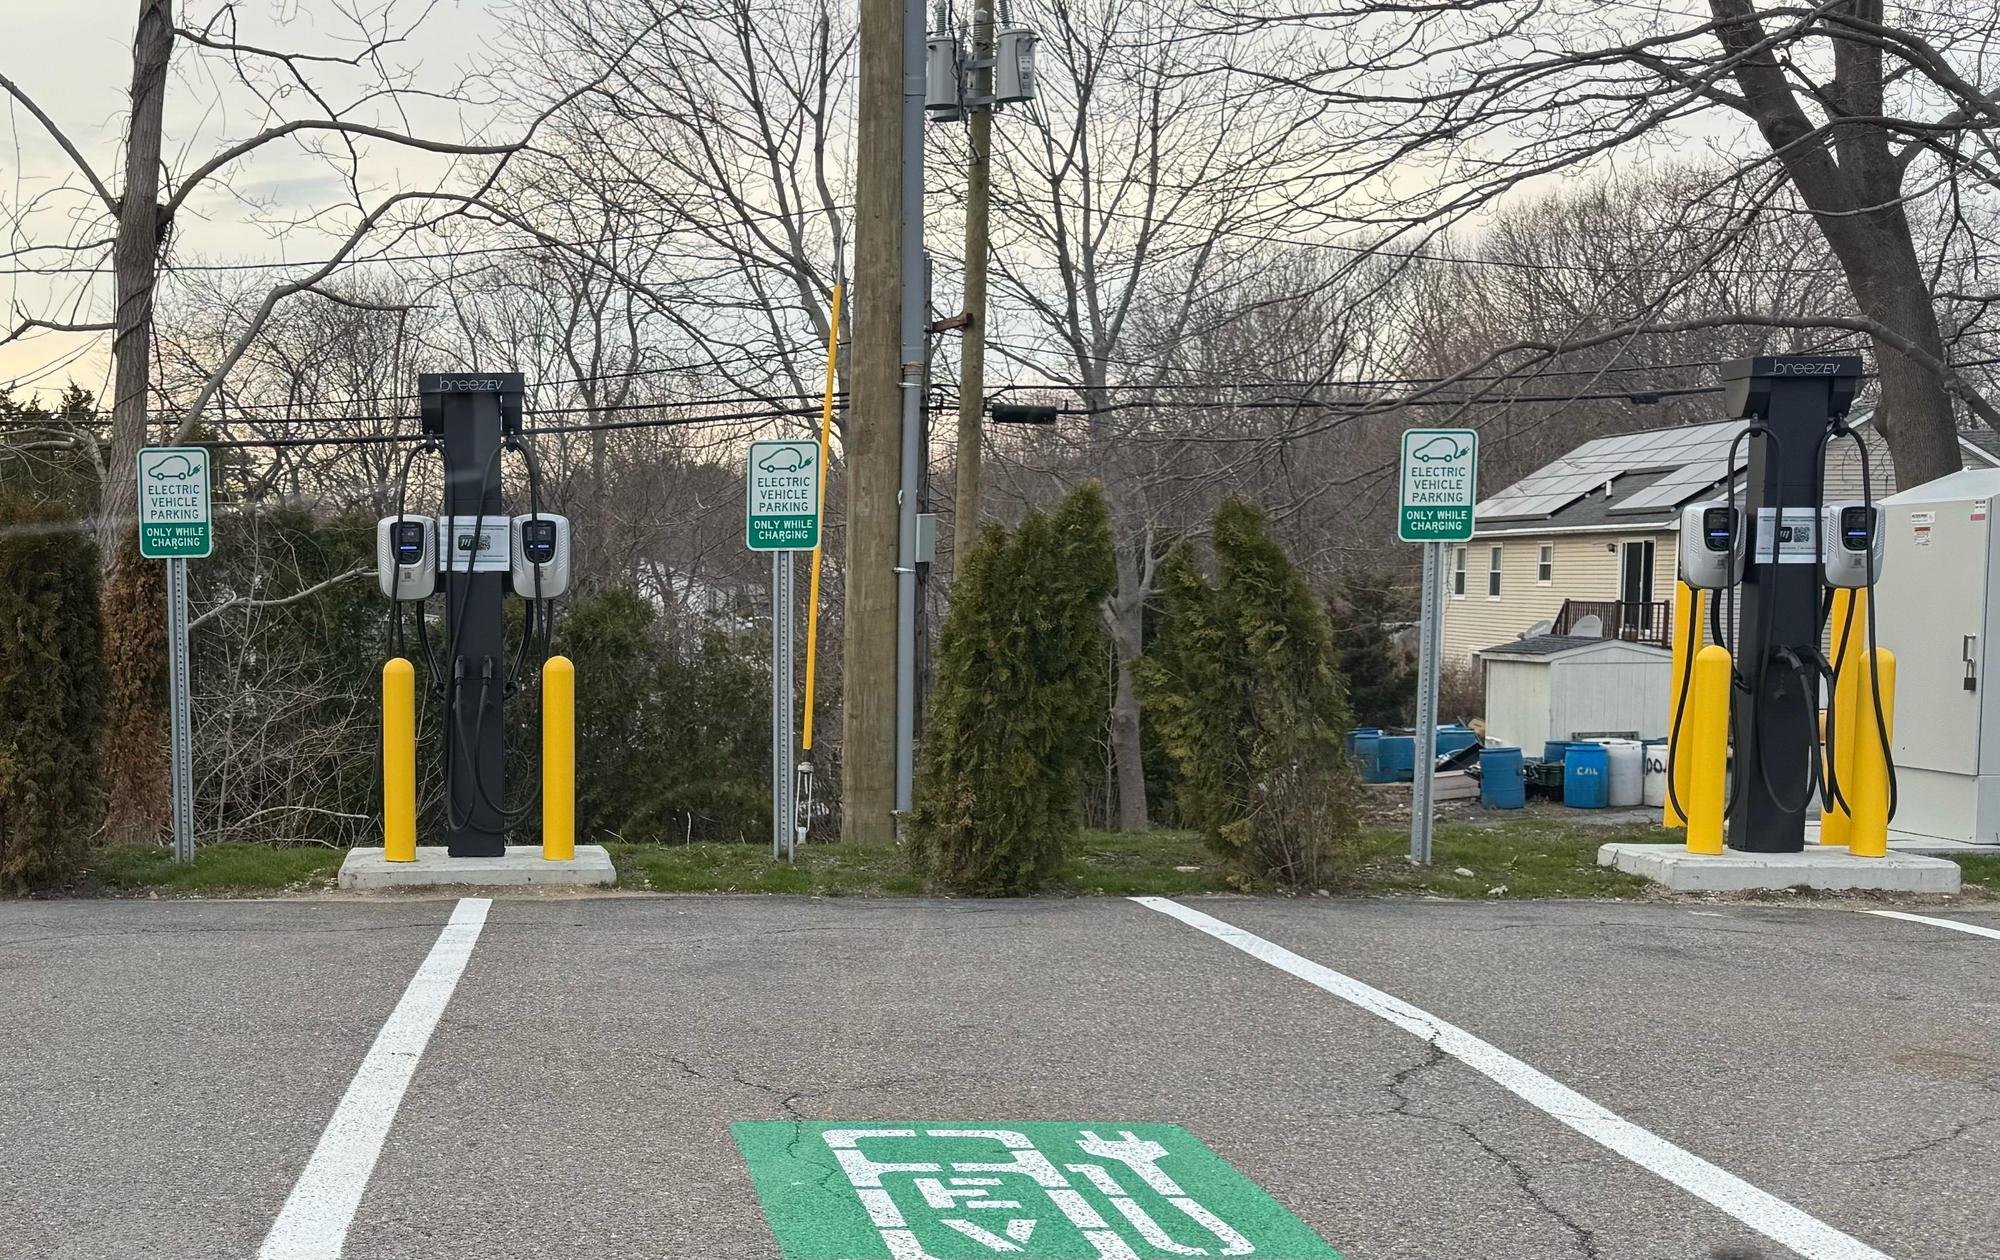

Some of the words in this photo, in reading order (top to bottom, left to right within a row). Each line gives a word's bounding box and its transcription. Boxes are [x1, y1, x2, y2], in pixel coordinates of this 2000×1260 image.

[1774, 359, 1840, 375] breezEV
[440, 376, 503, 391] breezEV
[1411, 467, 1466, 477] ELECTRIC
[757, 477, 810, 487] ELECTRIC
[1413, 479, 1463, 490] VEHICLE
[148, 485, 200, 495] ELECTRIC
[760, 489, 808, 500] VEHICLE
[151, 497, 198, 507] VEHICLE
[1412, 492, 1463, 502] PARKING
[759, 502, 808, 512] PARKING
[150, 509, 199, 519] PARKING
[1406, 510, 1434, 520] ONLY
[1436, 510, 1468, 520] WHILE
[754, 520, 780, 530] ONLY
[783, 519, 813, 529] WHILE
[1410, 521, 1463, 531] CHARGING
[146, 527, 173, 537] ONLY
[175, 527, 204, 536] WHILE
[758, 530, 808, 540] CHARGING
[151, 538, 200, 547] CHARGING
